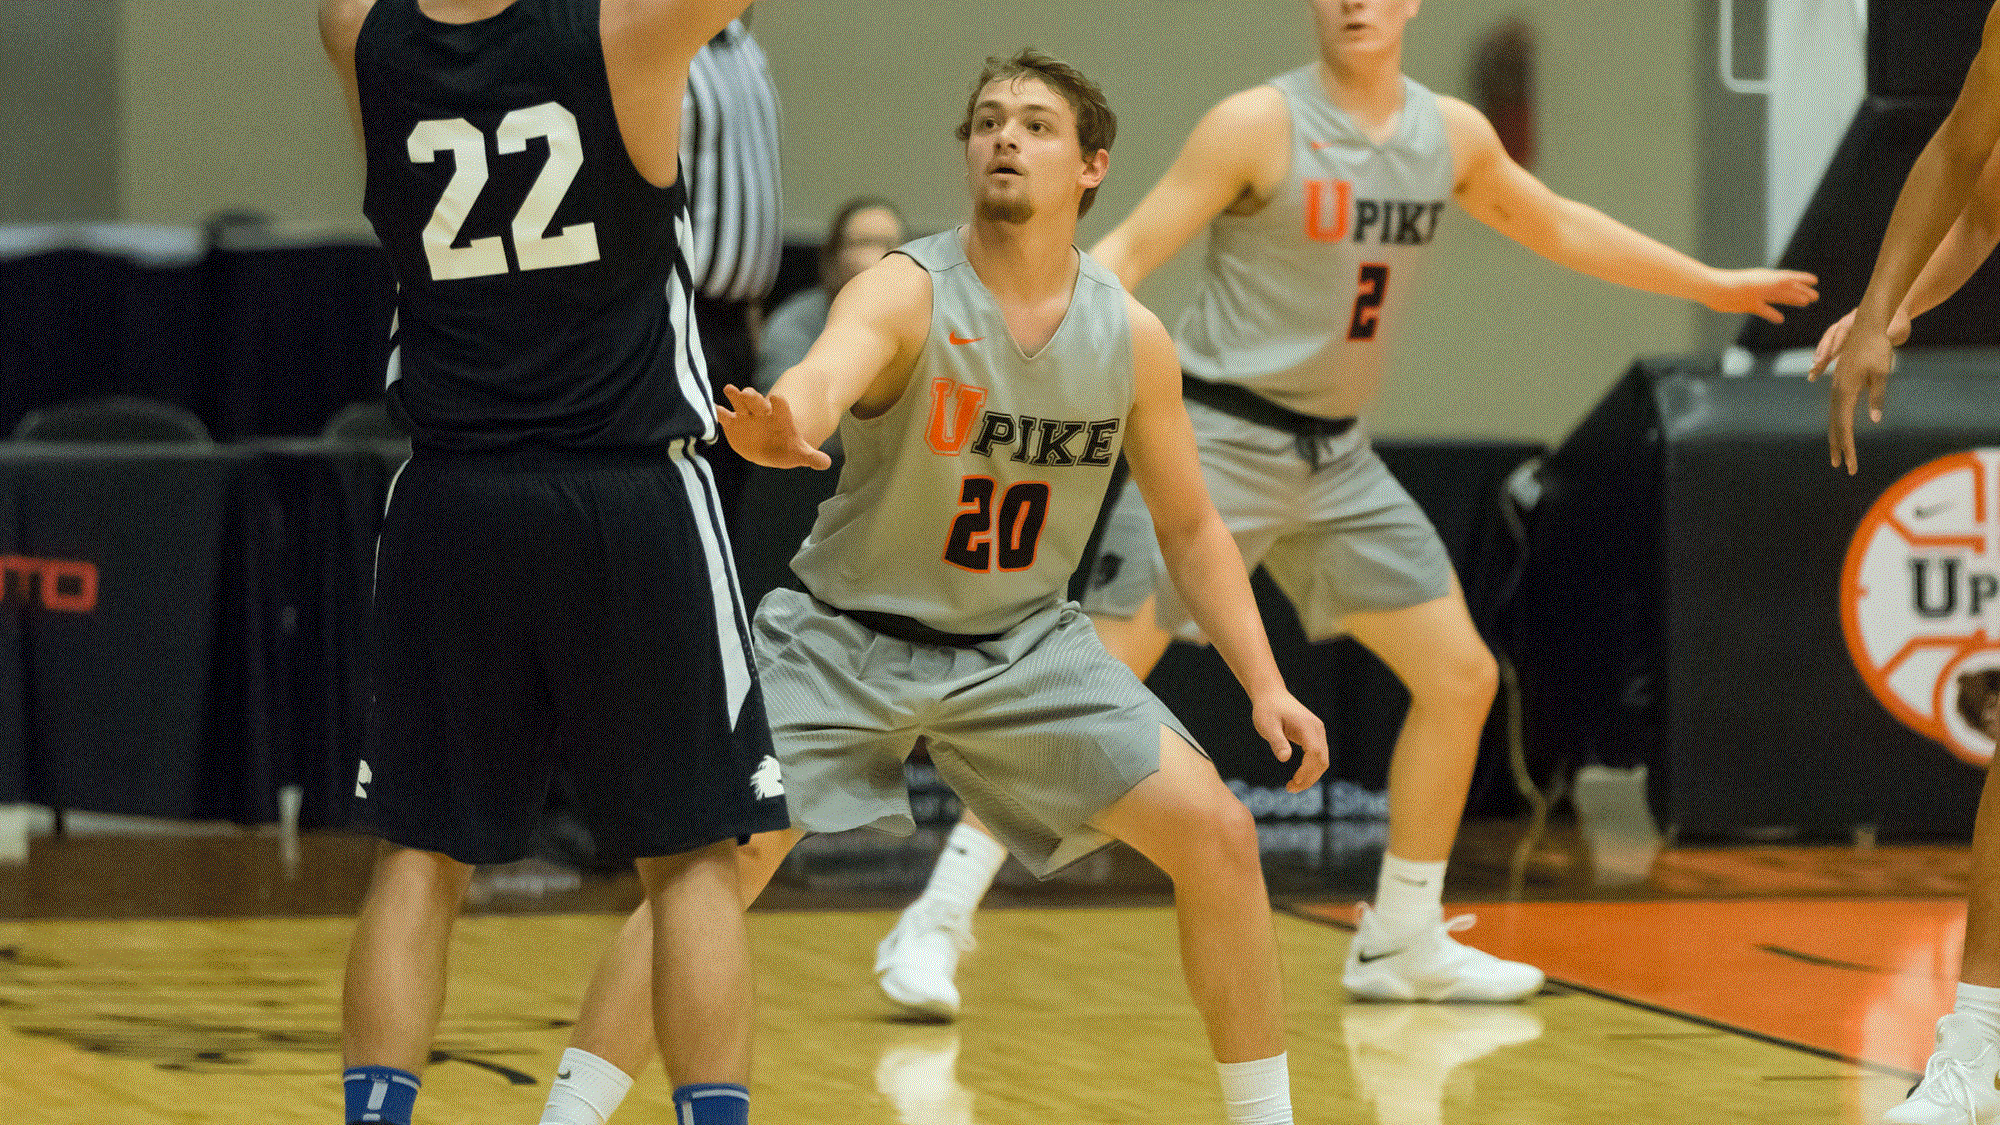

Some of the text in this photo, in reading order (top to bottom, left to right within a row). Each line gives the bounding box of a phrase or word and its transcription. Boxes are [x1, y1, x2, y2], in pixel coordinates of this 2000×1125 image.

[407, 101, 601, 281] 22
[1346, 262, 1390, 342] 2
[924, 377, 1120, 467] UPIKE
[942, 474, 1051, 574] 20
[0, 554, 98, 612] TO
